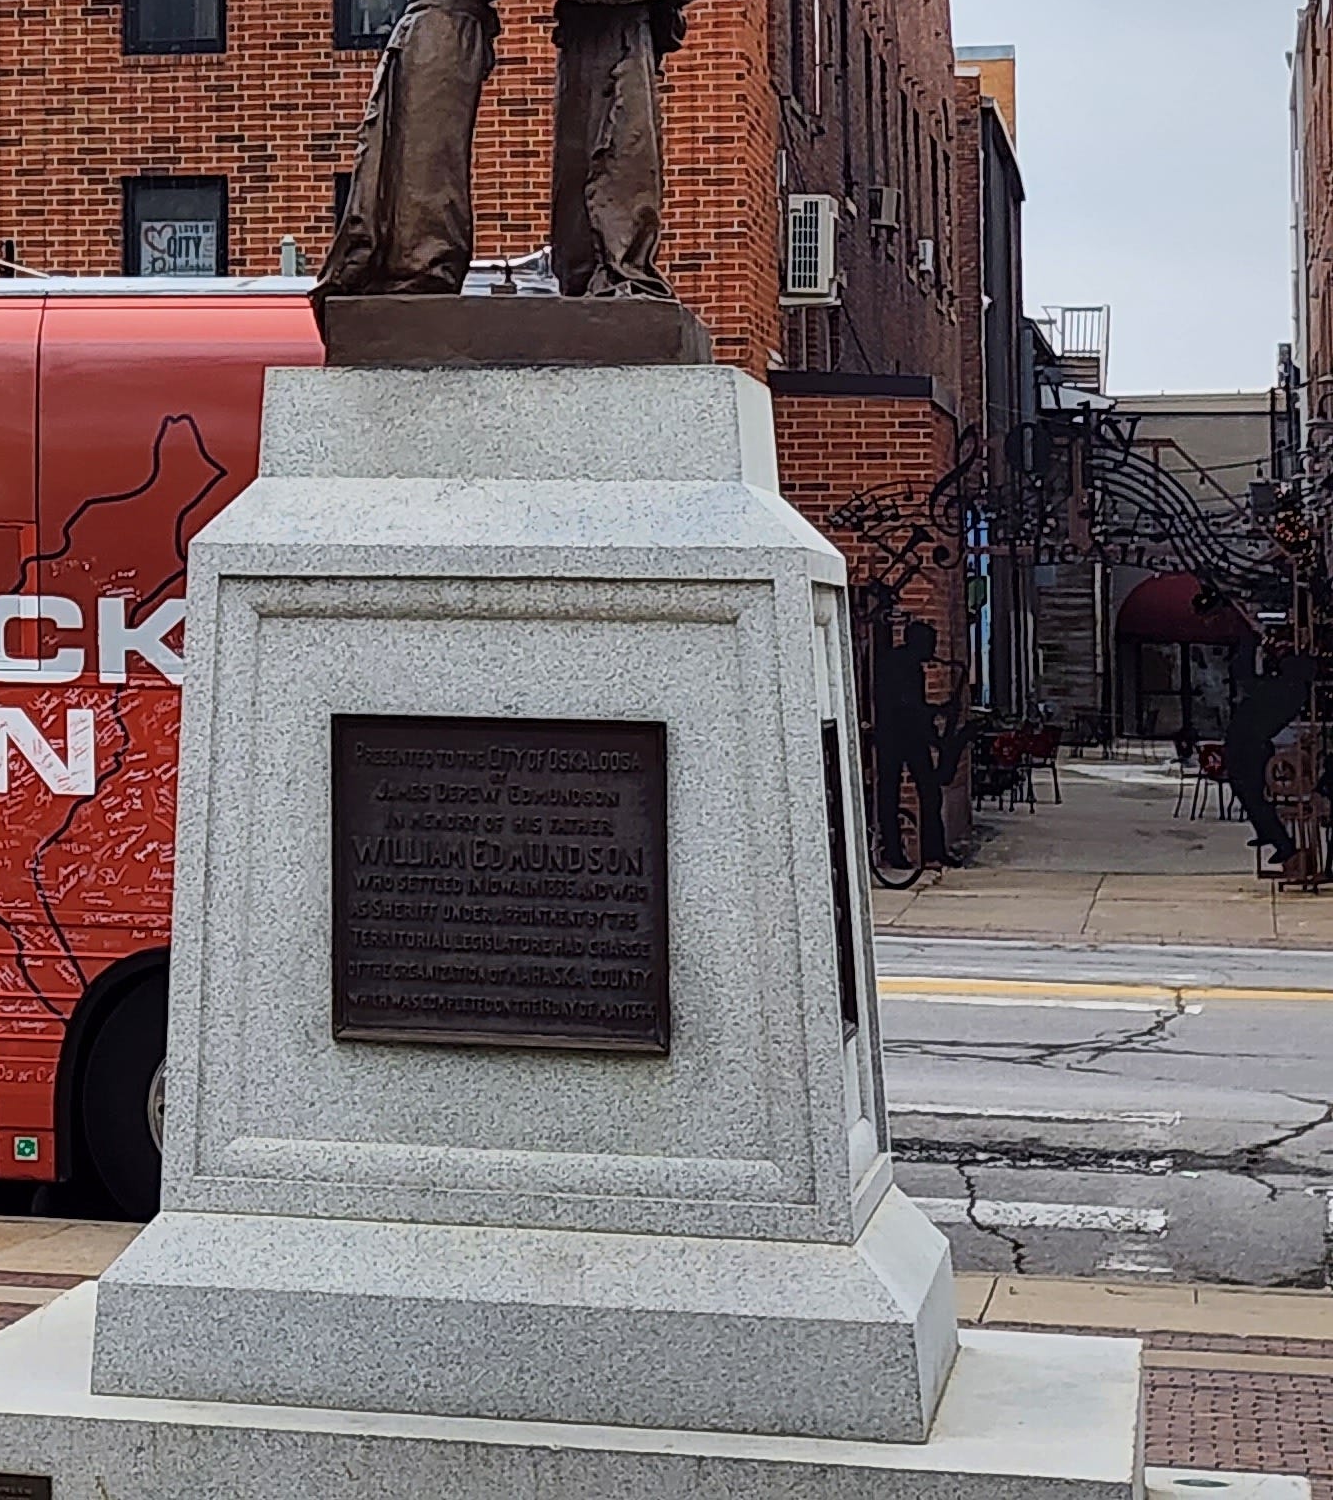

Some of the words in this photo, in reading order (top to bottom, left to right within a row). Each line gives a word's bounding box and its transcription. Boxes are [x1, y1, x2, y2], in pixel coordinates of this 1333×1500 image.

[356, 741, 433, 767] PRESENTED
[436, 749, 454, 768] TO
[456, 749, 486, 769] THE
[488, 744, 527, 771] CITY
[528, 749, 546, 771] OF
[548, 747, 642, 772] OSKALOOSA
[370, 779, 431, 801] JAMES
[435, 781, 501, 804] DEPEW
[508, 784, 620, 807] EDMUNDSON
[352, 836, 466, 868] WILLIAM
[471, 836, 644, 876] EDMUNDSON
[353, 872, 394, 892] WHO
[396, 874, 463, 894] SETTLED
[371, 898, 439, 921] SHERIFF
[442, 902, 493, 923] UNDER
[351, 927, 452, 950] TERRITORIAL
[453, 932, 552, 955] LEGISLATURE
[508, 966, 583, 987] MAHASKA
[589, 967, 653, 989] COUNTY
